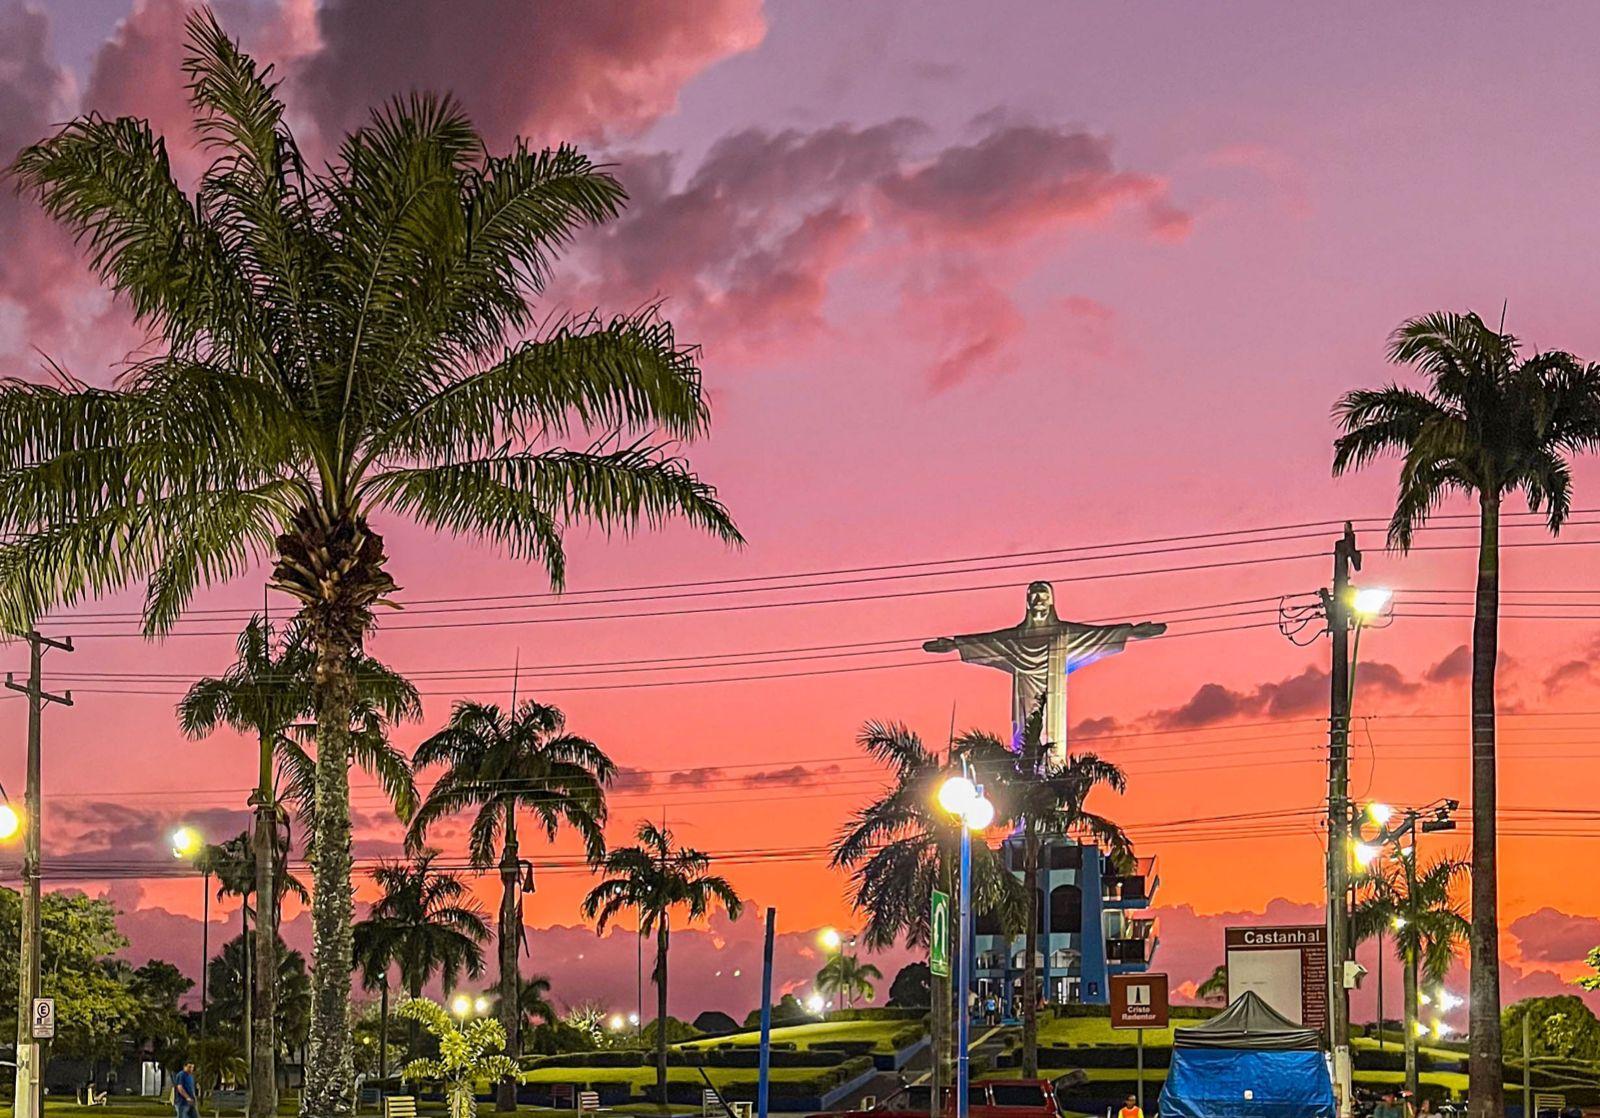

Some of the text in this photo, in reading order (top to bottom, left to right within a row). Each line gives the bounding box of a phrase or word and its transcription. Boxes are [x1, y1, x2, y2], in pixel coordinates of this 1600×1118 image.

[1244, 929, 1320, 944] Castanhal
[40, 1005, 47, 1015] E
[1127, 1005, 1151, 1013] Cristo
